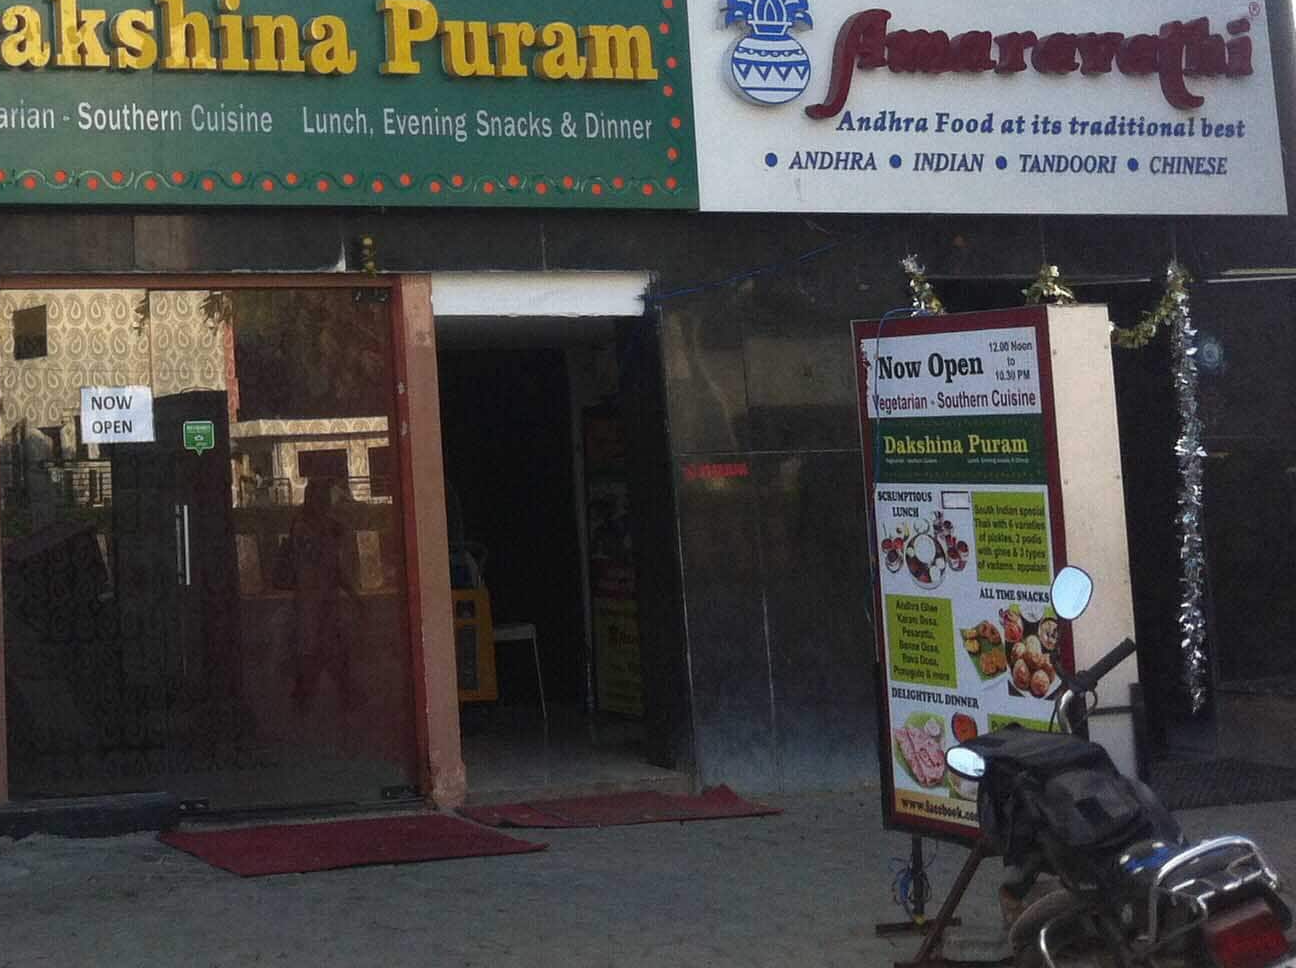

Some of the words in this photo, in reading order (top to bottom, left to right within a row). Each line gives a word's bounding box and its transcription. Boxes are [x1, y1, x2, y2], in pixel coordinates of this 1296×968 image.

[804, 8, 1254, 119] Amaravathi
[78, 102, 182, 132] Southern
[190, 103, 273, 133] Cuisine
[303, 106, 373, 136] Lunch,
[383, 107, 465, 141] Evening
[476, 110, 553, 138] Snacks
[561, 112, 576, 139] &
[585, 113, 653, 140] Dinner
[836, 111, 928, 135] Andhra
[935, 113, 994, 135] Food
[1001, 116, 1026, 136] at
[1031, 115, 1062, 136] its
[1069, 115, 1196, 138] traditional
[1201, 117, 1246, 139] best
[789, 152, 878, 171] ANDHRA
[912, 153, 985, 173] INDIAN
[1018, 155, 1117, 174] TANDOORI
[1149, 156, 1228, 176] CHINESE
[1011, 341, 1033, 351] Noon
[877, 355, 921, 380] Now
[928, 352, 984, 383] Open
[1007, 357, 1015, 366] to
[1017, 369, 1030, 381] PM
[90, 394, 133, 412] NOW
[872, 395, 928, 415] Vegetarian
[937, 391, 988, 409] Southern
[991, 390, 1036, 407] Cuisine
[91, 419, 133, 436] OPEN
[883, 435, 963, 455] Dakshina
[968, 433, 1029, 454] Puram
[878, 490, 932, 502] SCRUMPTIOUS
[892, 507, 919, 518] LUNCH
[980, 588, 997, 600] ALL
[998, 589, 1015, 601] TIME
[1017, 590, 1050, 603] SNACKS
[891, 688, 943, 705] DELIGHTFUL
[944, 695, 979, 709] DINNER
